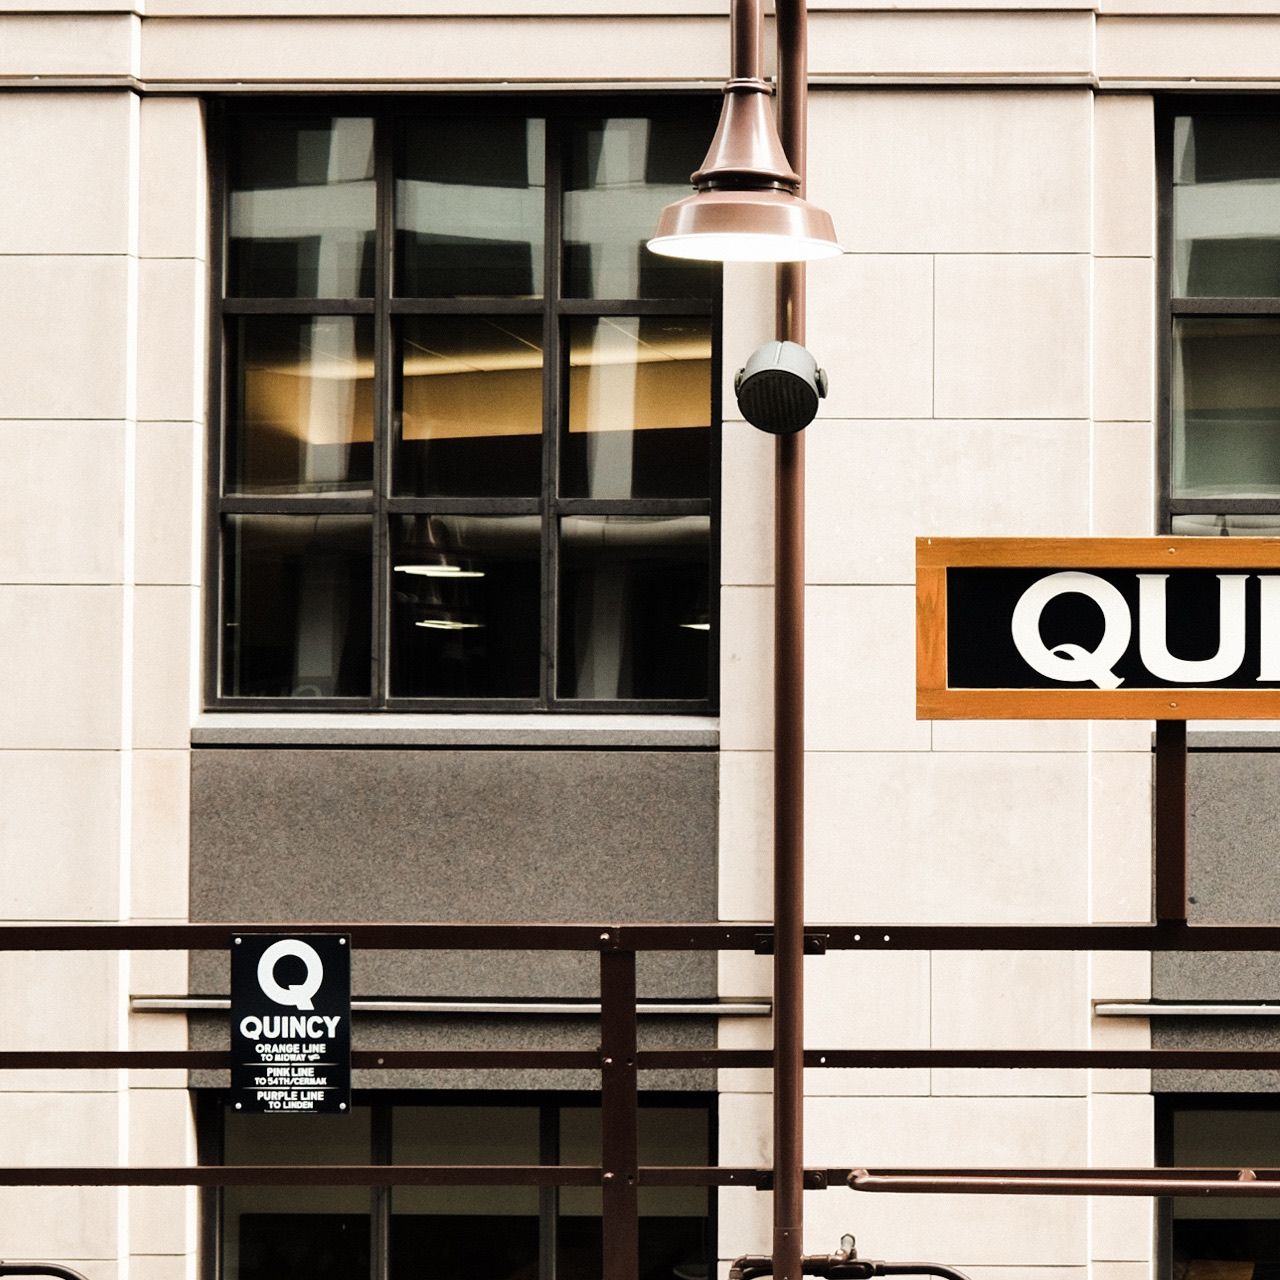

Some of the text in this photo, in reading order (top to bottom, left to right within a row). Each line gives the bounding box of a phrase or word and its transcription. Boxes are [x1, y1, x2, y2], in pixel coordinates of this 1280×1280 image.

[257, 939, 324, 1010] Q
[239, 1015, 341, 1040] QUINCY
[255, 1043, 326, 1053] ORANGE LINE
[260, 1053, 306, 1062] TO MIDWAY
[266, 1067, 315, 1077] PINK LINE
[254, 1077, 327, 1085] TO 54TH/CERMAK
[257, 1091, 325, 1101] PURPLE LINE
[268, 1101, 314, 1109] TO LINDEN
